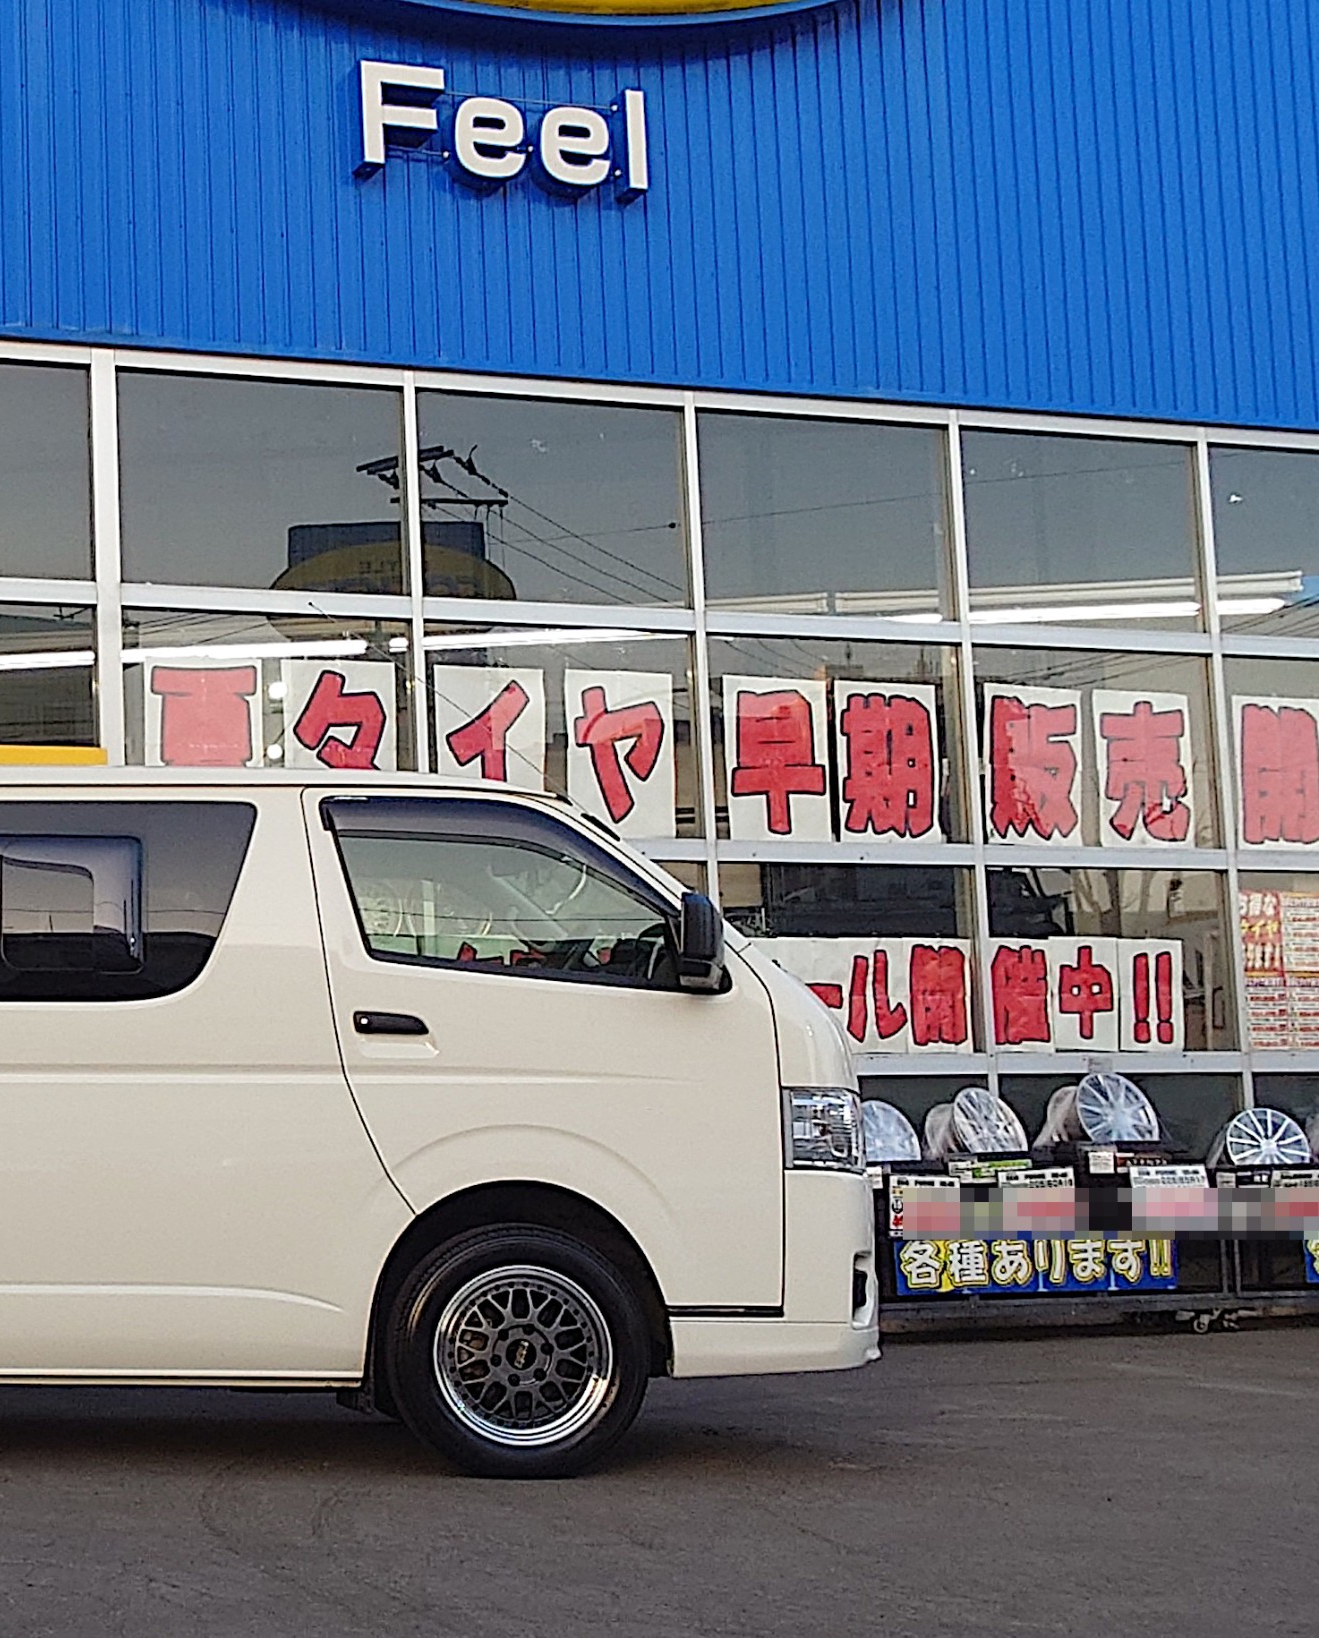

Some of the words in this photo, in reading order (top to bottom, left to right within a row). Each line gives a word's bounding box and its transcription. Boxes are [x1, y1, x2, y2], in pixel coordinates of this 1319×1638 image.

[359, 60, 649, 191] Feel
[806, 944, 1174, 1045] ール開催中!!
[902, 1239, 1173, 1288] 各種あります!!
